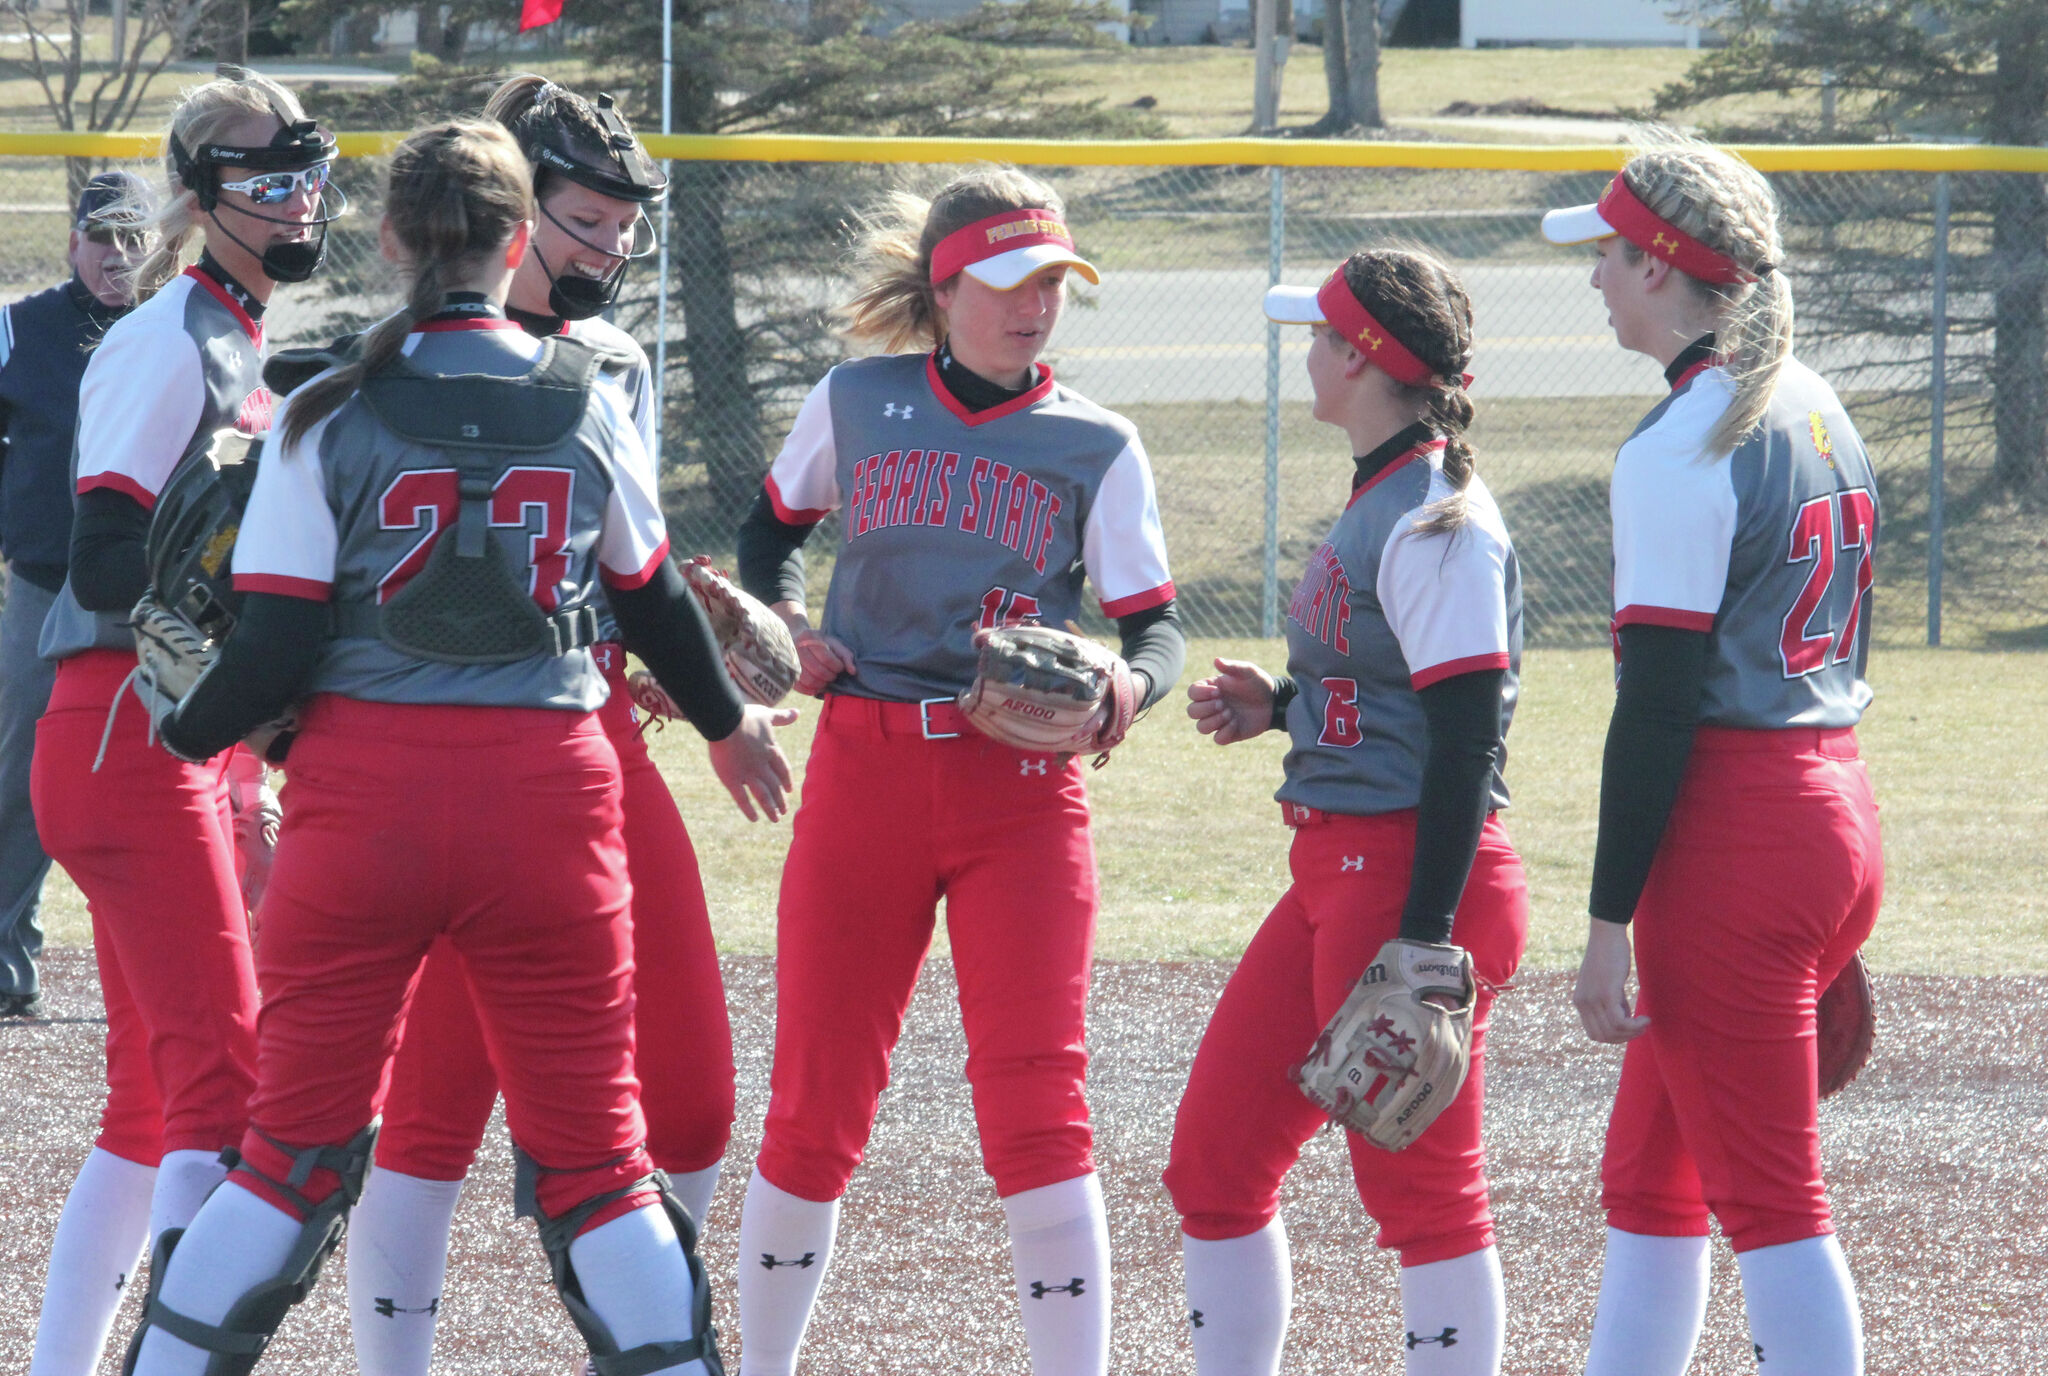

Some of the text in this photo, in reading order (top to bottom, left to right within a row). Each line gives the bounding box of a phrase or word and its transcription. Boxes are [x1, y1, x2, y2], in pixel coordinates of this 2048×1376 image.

[376, 465, 576, 614] 23
[848, 448, 1063, 577] FERRIS STATE
[1778, 487, 1875, 680] 27
[1002, 698, 1056, 720] A2000
[1317, 677, 1364, 748] 6
[1418, 962, 1460, 978] Wilson
[1395, 1082, 1433, 1126] A2000
